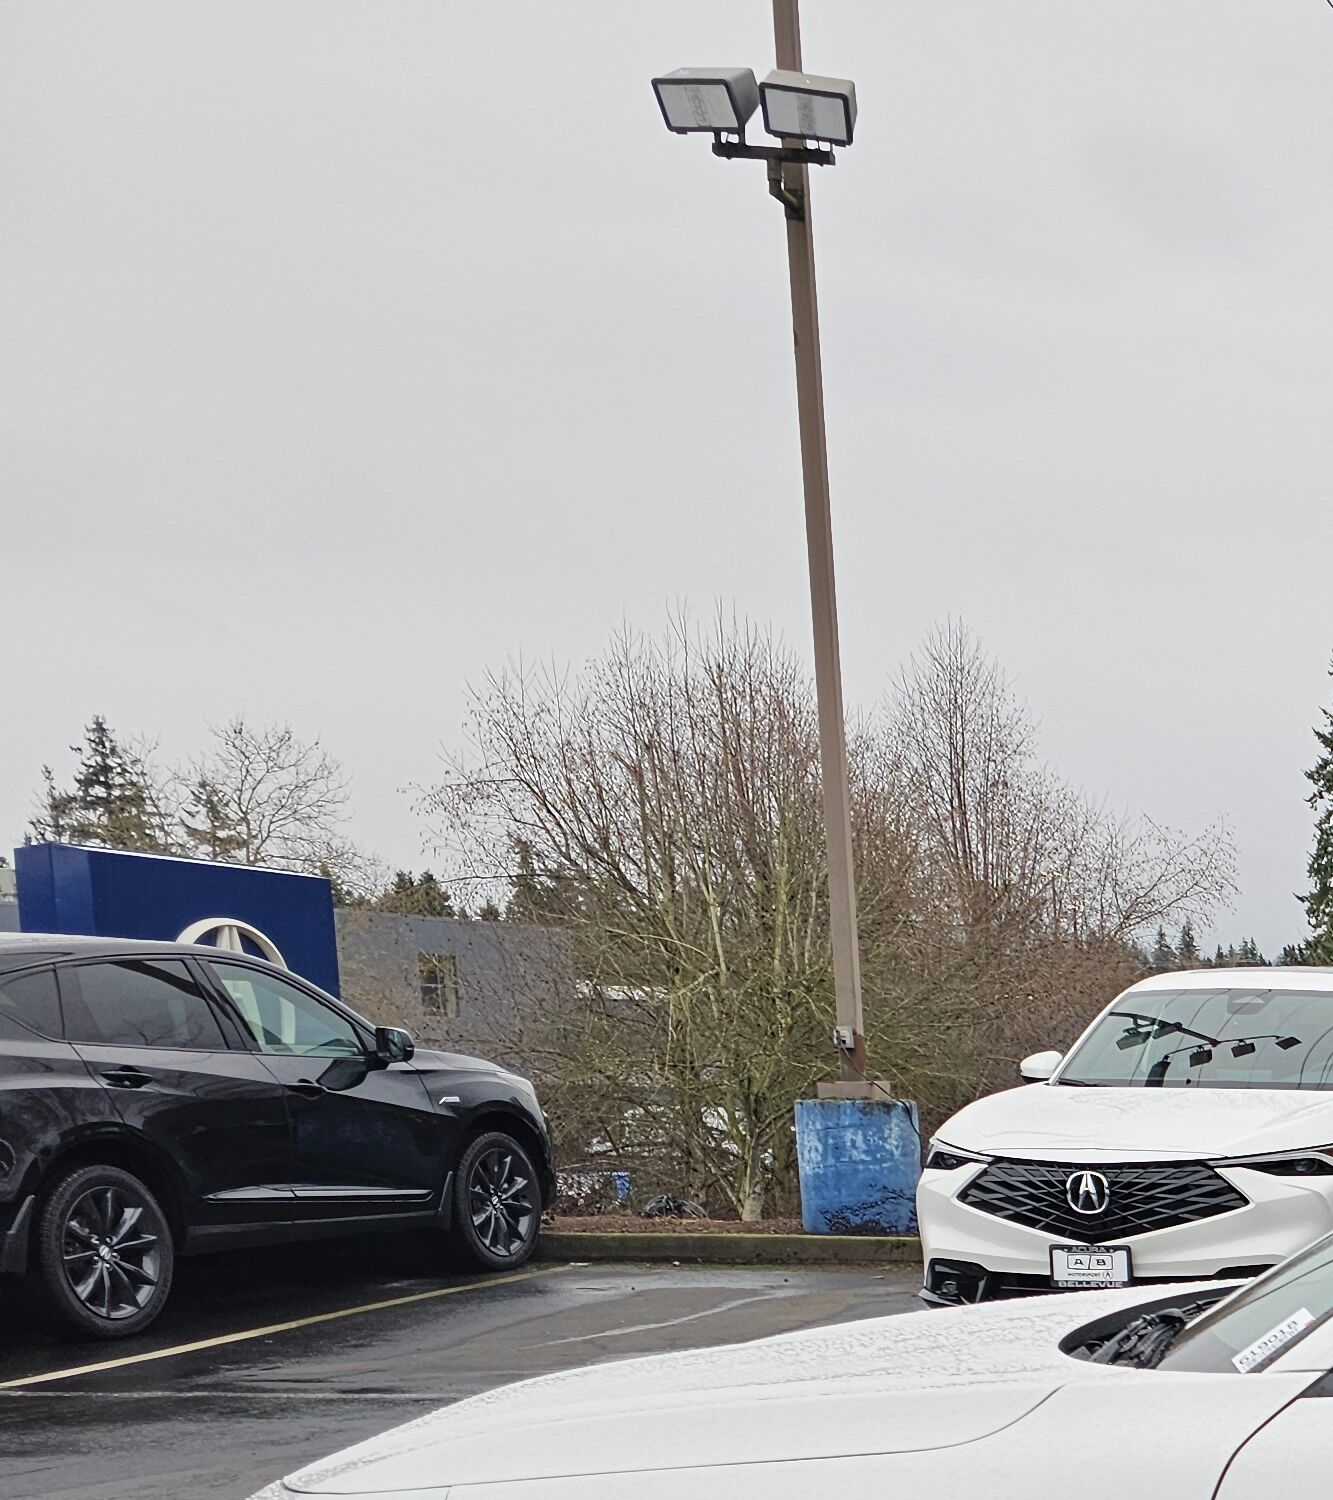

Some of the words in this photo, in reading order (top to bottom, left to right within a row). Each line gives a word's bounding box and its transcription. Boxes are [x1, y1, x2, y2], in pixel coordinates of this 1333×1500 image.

[1073, 1258, 1084, 1266] A
[1096, 1258, 1107, 1266] B
[1058, 1280, 1123, 1288] BELLEVUE
